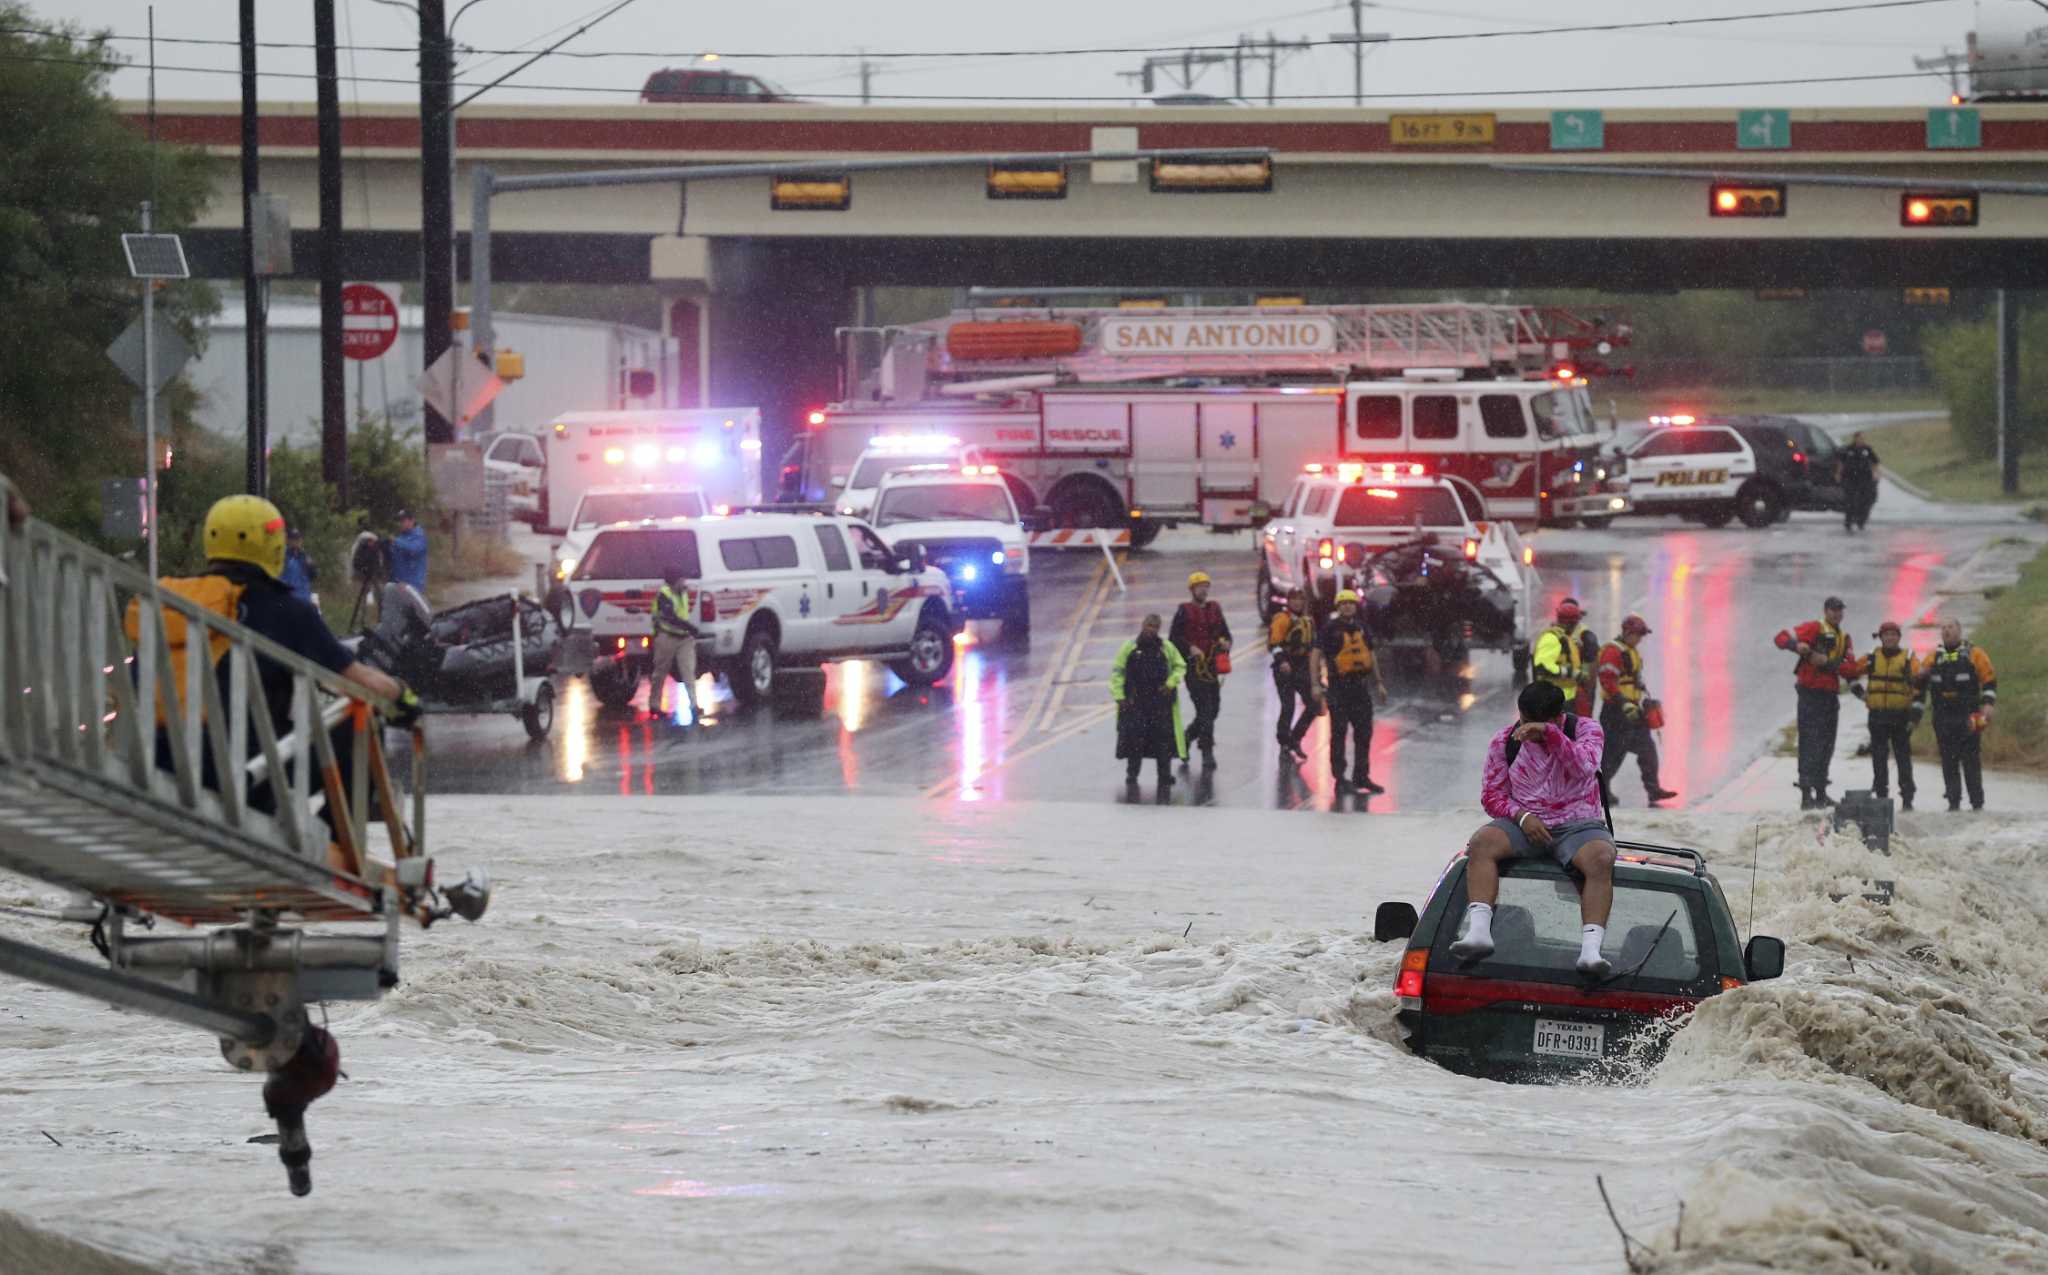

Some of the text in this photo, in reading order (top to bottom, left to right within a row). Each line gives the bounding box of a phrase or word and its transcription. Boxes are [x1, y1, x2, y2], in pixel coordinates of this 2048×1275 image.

[1401, 120, 1420, 138] 16
[1116, 323, 1321, 347] SAN ANTONIO
[994, 428, 1122, 441] FIRE RESCUE
[1656, 467, 1728, 488] POLICE
[1556, 1022, 1584, 1033] TEXAS
